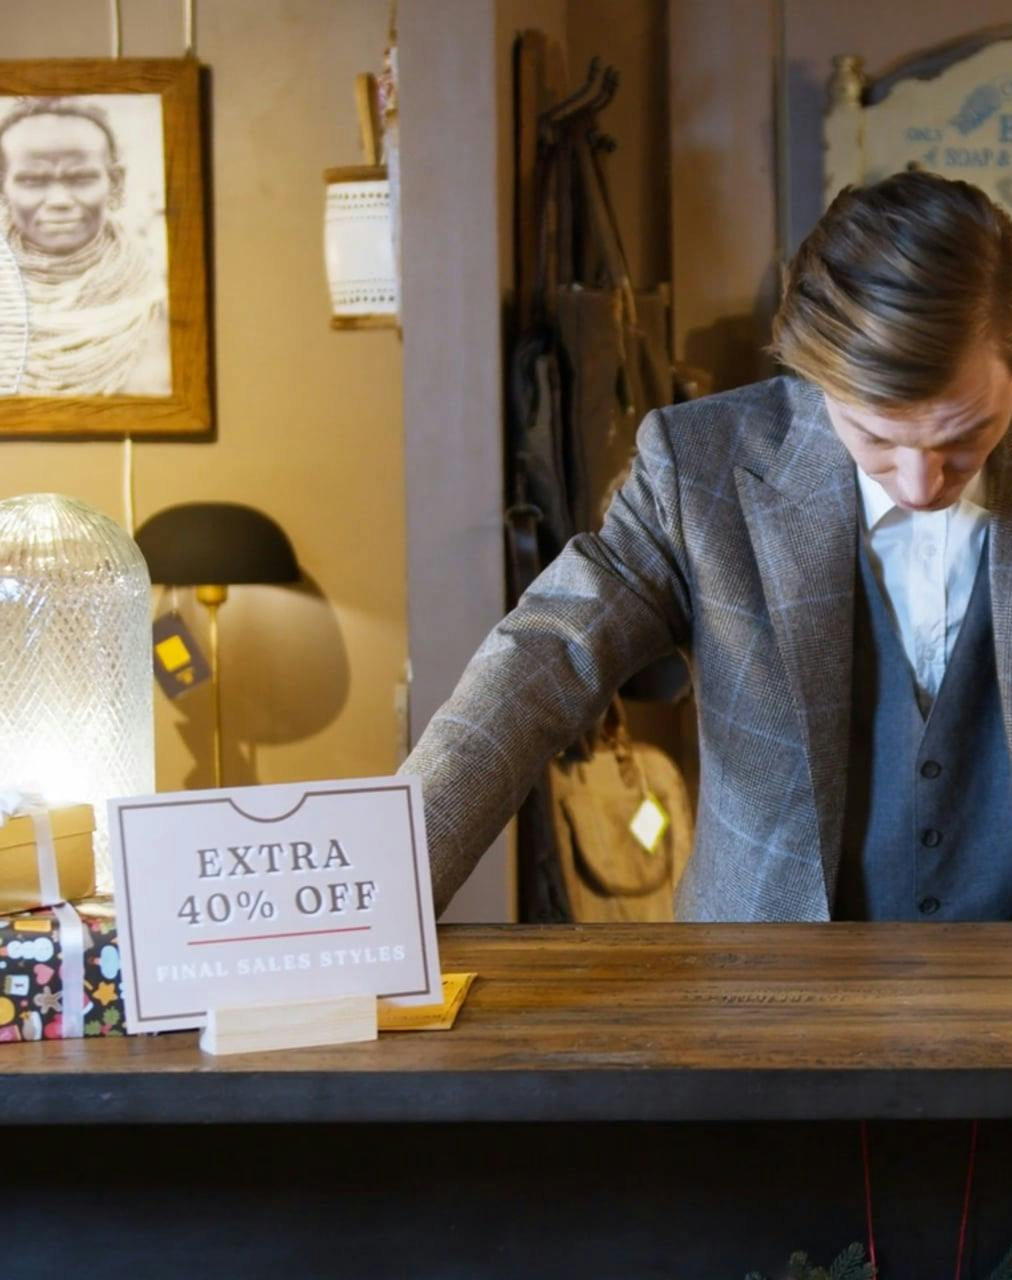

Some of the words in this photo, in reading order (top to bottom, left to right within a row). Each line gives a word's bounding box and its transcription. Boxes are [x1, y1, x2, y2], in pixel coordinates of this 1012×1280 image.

[944, 147, 993, 166] SOAP
[196, 839, 351, 878] EXTRA
[177, 890, 274, 925] 40%
[295, 881, 376, 915] OFF
[156, 962, 229, 982] FINAL
[237, 952, 312, 975] SALES
[319, 945, 406, 968] STYLES
